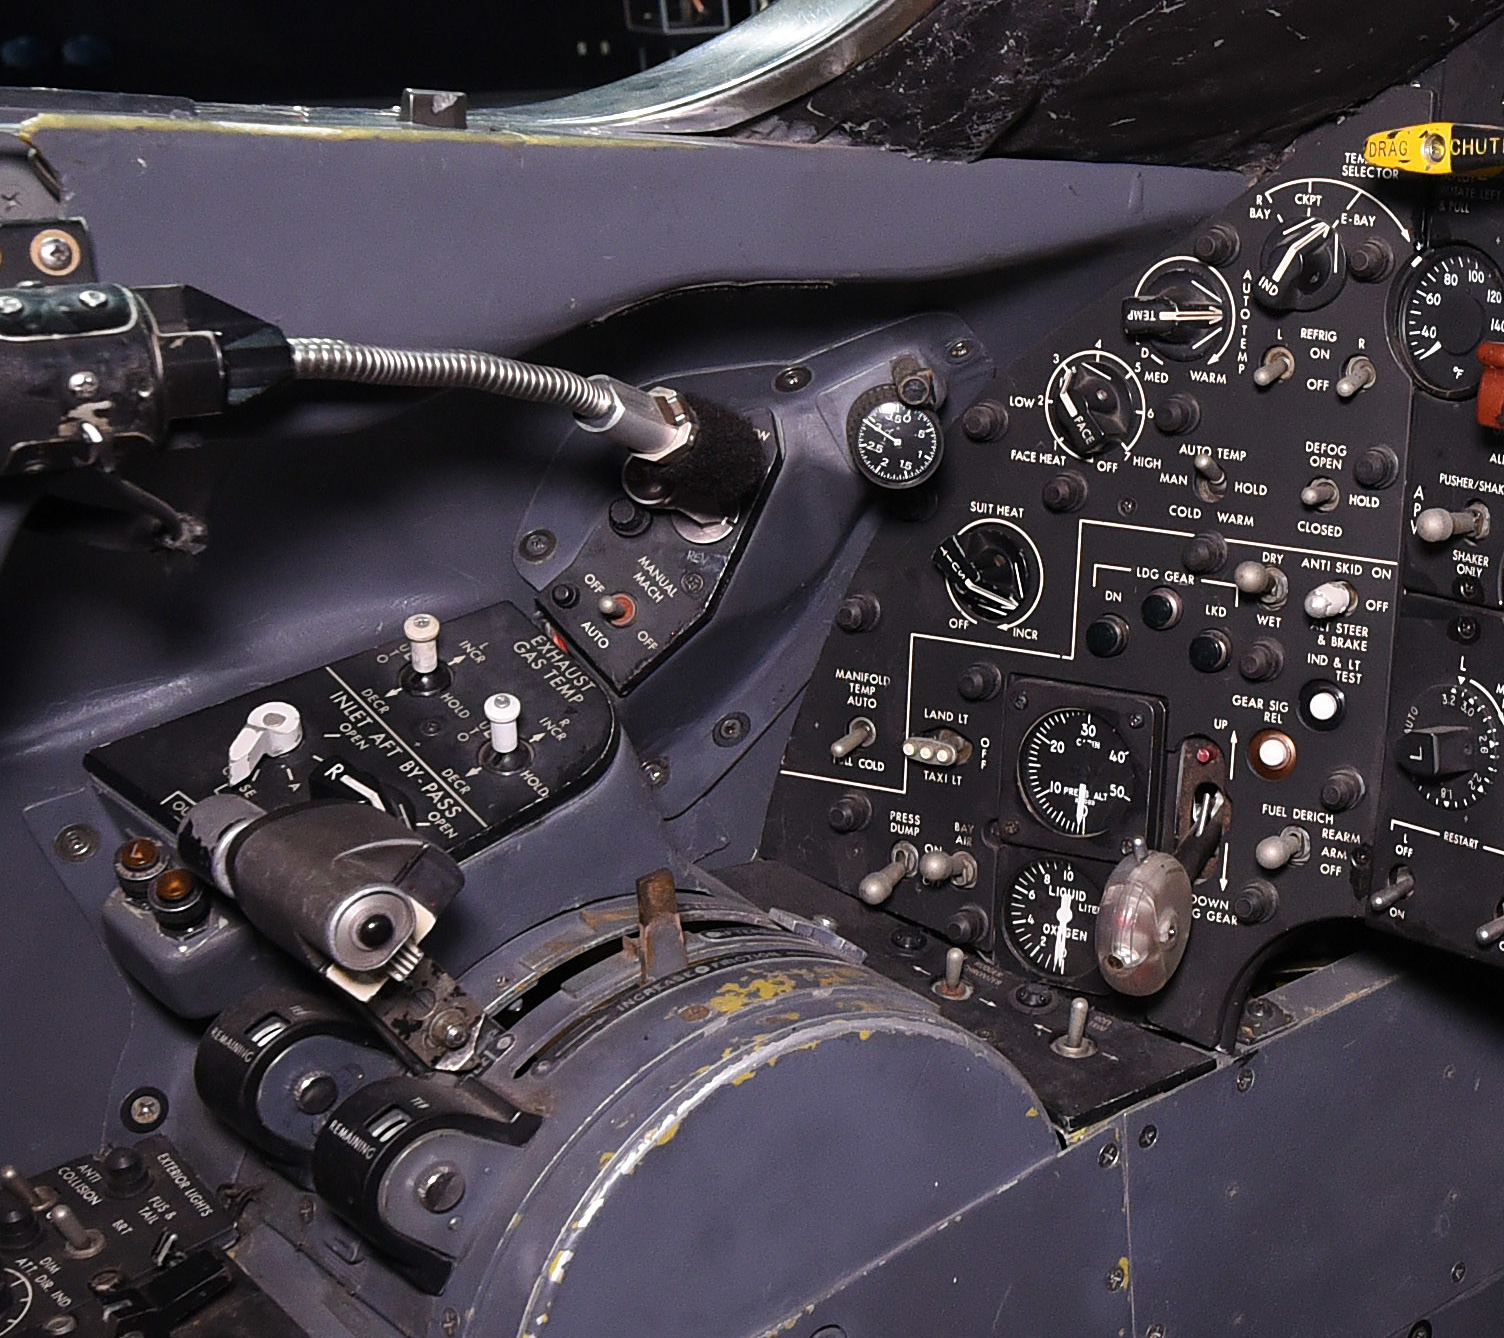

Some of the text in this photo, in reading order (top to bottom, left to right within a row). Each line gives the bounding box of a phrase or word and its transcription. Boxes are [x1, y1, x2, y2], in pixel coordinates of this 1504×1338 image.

[1368, 140, 1408, 156] DRAG
[1342, 164, 1399, 179] SELECTOR
[1295, 194, 1322, 206] CKPT
[1250, 207, 1271, 219] BAY
[1341, 213, 1376, 227] E-BAY
[1301, 328, 1337, 342] REFRIG
[1144, 371, 1168, 383] MED
[1190, 370, 1226, 384] WARM
[1179, 444, 1246, 462] AUTO TEMP
[1306, 441, 1347, 456] DEFOG
[1011, 450, 1066, 466] FACE HEAT
[1133, 456, 1161, 469] HIGH
[1310, 456, 1342, 469] OPEN
[1097, 461, 1117, 473] OFF
[1160, 473, 1187, 485] MAN
[1235, 482, 1267, 495] HOLD
[1349, 494, 1379, 507] HOLD
[970, 501, 1024, 518] SUIT HEAT
[1169, 505, 1201, 518] COLD
[1217, 512, 1253, 527] WARM
[1298, 521, 1342, 537] CLOSED
[1263, 552, 1283, 564] DRY
[1453, 550, 1489, 567] SHAKER
[1137, 567, 1194, 585] LDG GEAR
[1301, 558, 1391, 579] ANTI SKID ON
[1457, 564, 1482, 577] ONLY
[636, 555, 678, 599] MANUAL
[632, 570, 665, 602] MACH
[1366, 600, 1388, 612] OFF
[1257, 614, 1281, 628] WET
[581, 622, 609, 648] AUTO
[531, 634, 595, 692] EXHAUST
[1308, 653, 1360, 671] IND & LT
[513, 641, 585, 704] GAS TEMP
[836, 669, 890, 687] MANIFOLD
[1336, 670, 1362, 684] TEST
[849, 683, 875, 695] TEMP
[847, 696, 877, 708] AUTO
[1232, 695, 1288, 712] GEAR SIG
[925, 708, 968, 724] LAND LT
[1264, 712, 1282, 724] REL
[330, 692, 462, 820] INLET AFT BY-PASS
[923, 769, 962, 785] TAXI LT
[890, 811, 920, 825] PRESS
[1262, 804, 1333, 825] FUEL DERICH
[891, 822, 919, 836] DUMP
[1048, 885, 1088, 902] LIQUID
[211, 1027, 254, 1063] REMAINING
[329, 1119, 376, 1159] REMAINING
[157, 1152, 214, 1218] EXTERIOR LIGHTS
